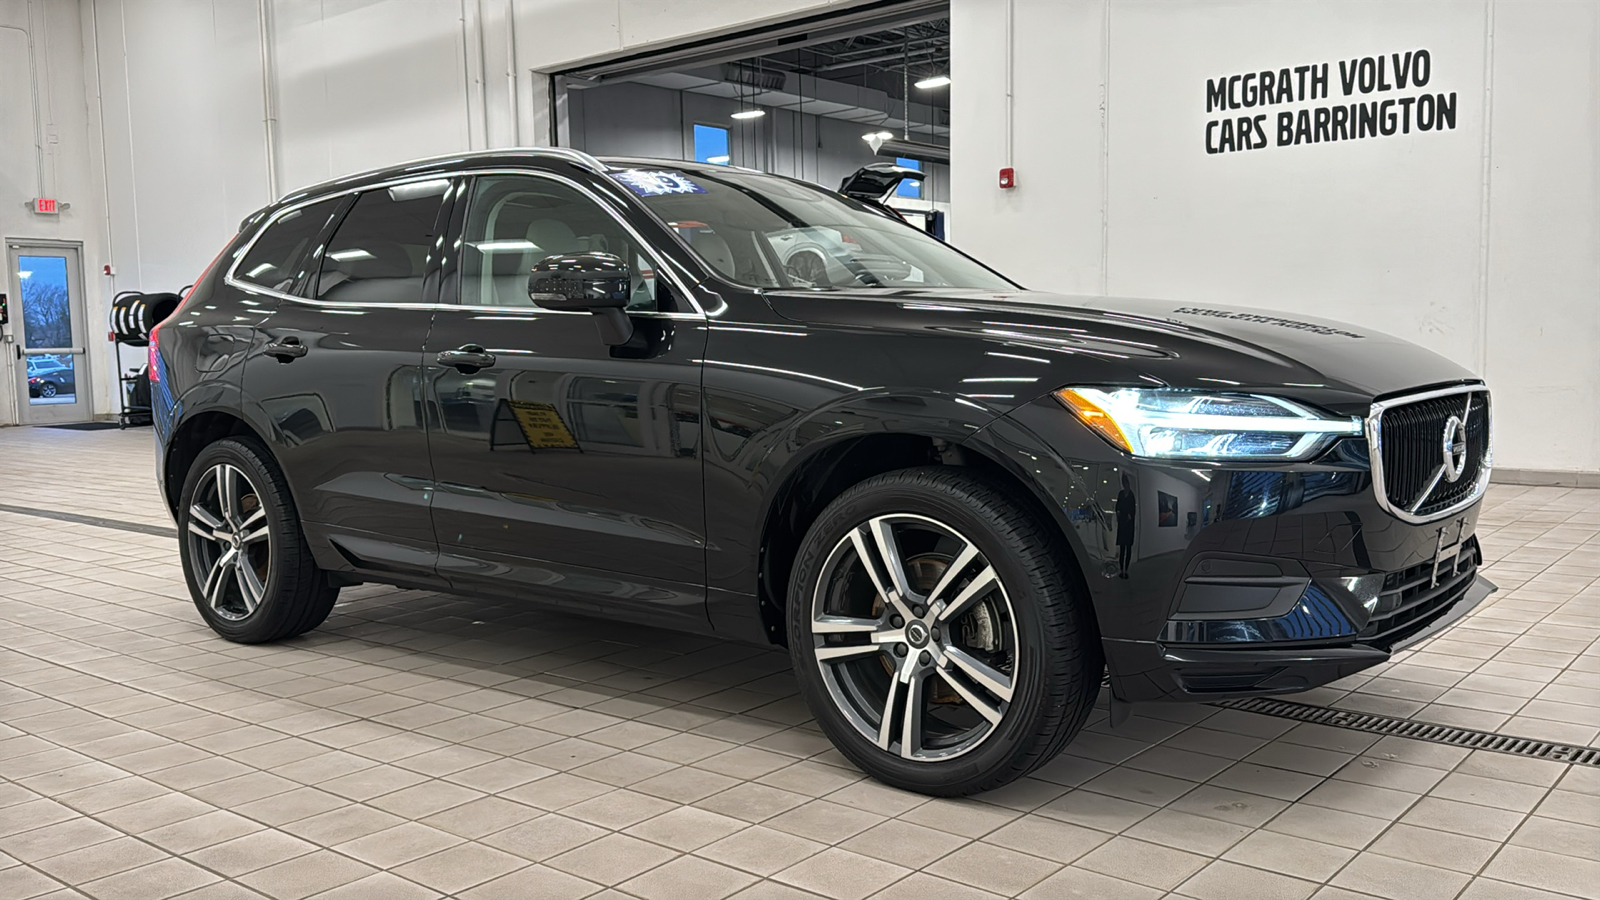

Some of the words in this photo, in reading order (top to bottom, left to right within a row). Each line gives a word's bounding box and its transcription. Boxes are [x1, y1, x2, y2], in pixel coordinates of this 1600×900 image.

[1206, 63, 1329, 113] MCGRATH
[1338, 49, 1431, 96] VOLVO
[1205, 114, 1268, 155] CARS
[1276, 92, 1457, 147] BARRINGTON
[38, 199, 55, 212] EXIT
